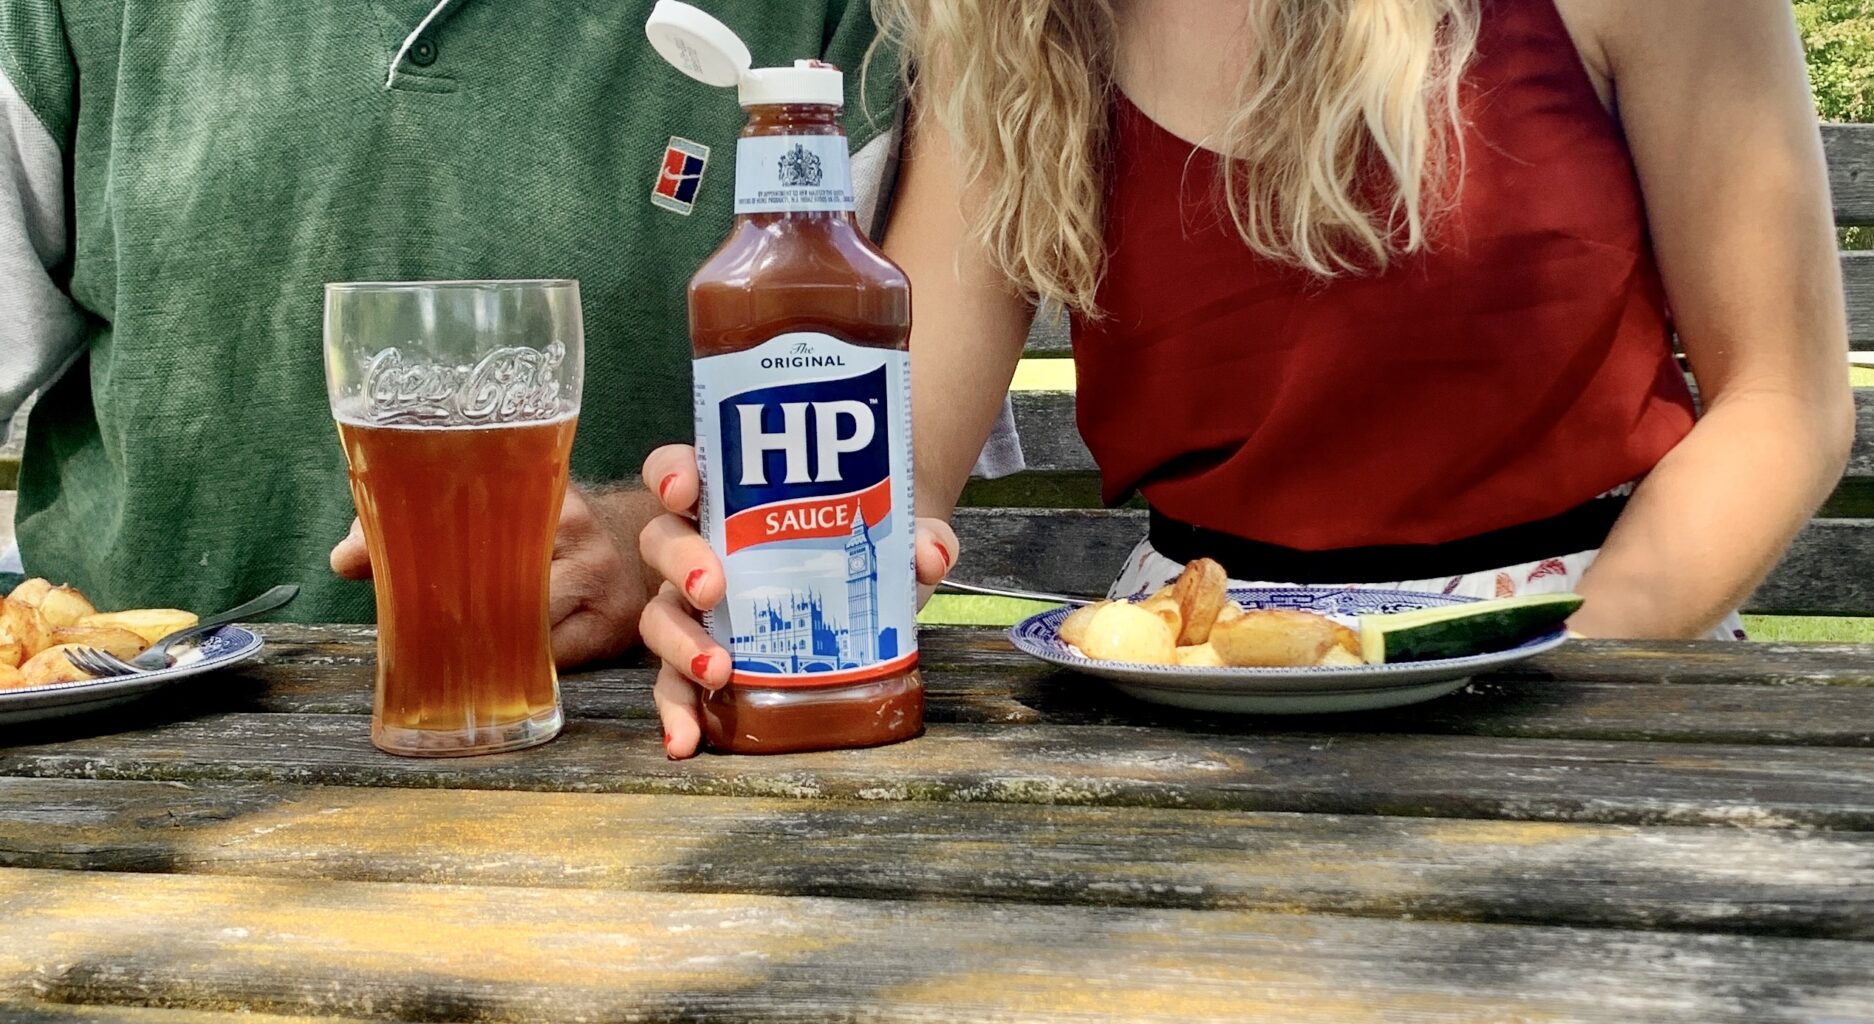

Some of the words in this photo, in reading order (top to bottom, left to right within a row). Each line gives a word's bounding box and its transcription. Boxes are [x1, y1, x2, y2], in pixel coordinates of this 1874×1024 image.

[789, 342, 814, 355] The
[761, 355, 845, 369] ORIGINAL
[735, 399, 876, 486] HP
[765, 504, 849, 535] SAUCE
